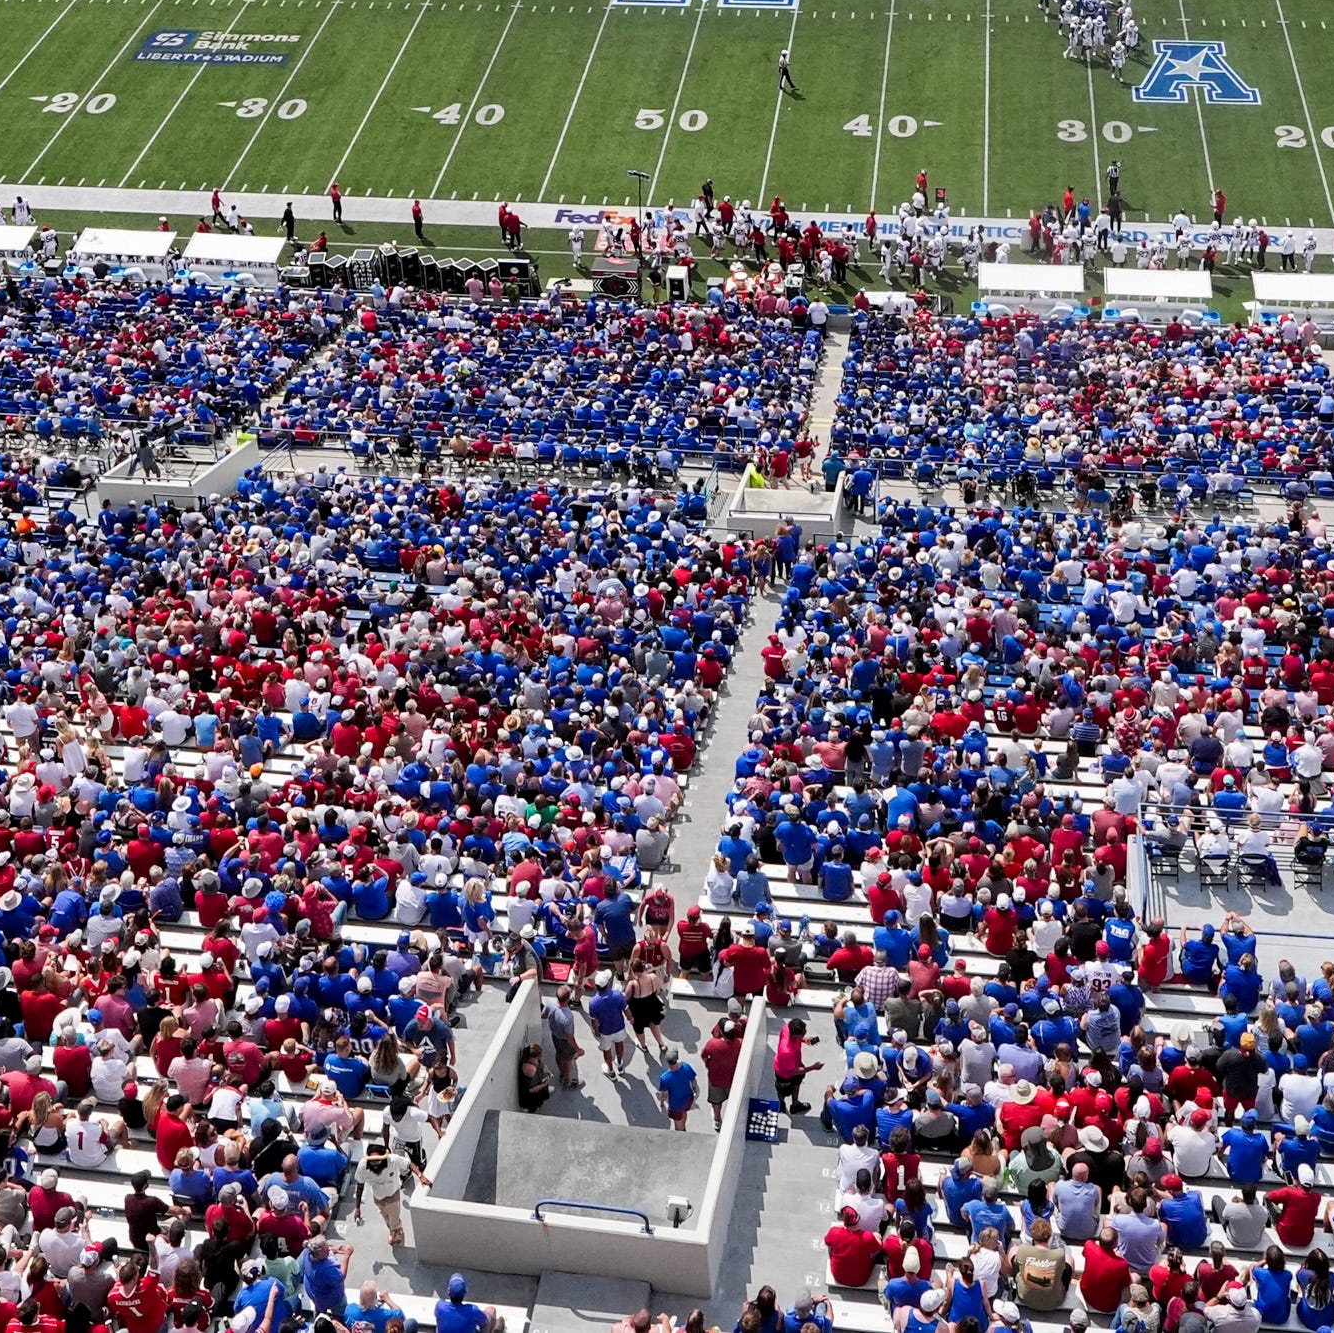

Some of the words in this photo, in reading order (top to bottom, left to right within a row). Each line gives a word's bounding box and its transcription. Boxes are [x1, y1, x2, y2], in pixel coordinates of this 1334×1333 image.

[198, 31, 300, 43] Simmons
[193, 40, 250, 51] Bank
[137, 52, 203, 61] LIBERTY
[213, 54, 284, 64] STADIUM
[42, 92, 117, 114] 20
[235, 98, 308, 120] 30
[432, 103, 505, 126] 40
[635, 109, 708, 132] 50
[842, 114, 918, 137] 40
[1057, 119, 1133, 143] 30
[555, 209, 638, 225] FedEx
[819, 221, 900, 236] MEMHIS
[51, 836, 60, 849] 5
[344, 865, 354, 881] 5
[1109, 924, 1129, 939] TAG
[1092, 978, 1112, 993] 93
[164, 987, 171, 1004] 1
[77, 1132, 84, 1151] 1
[897, 1165, 906, 1191] 1
